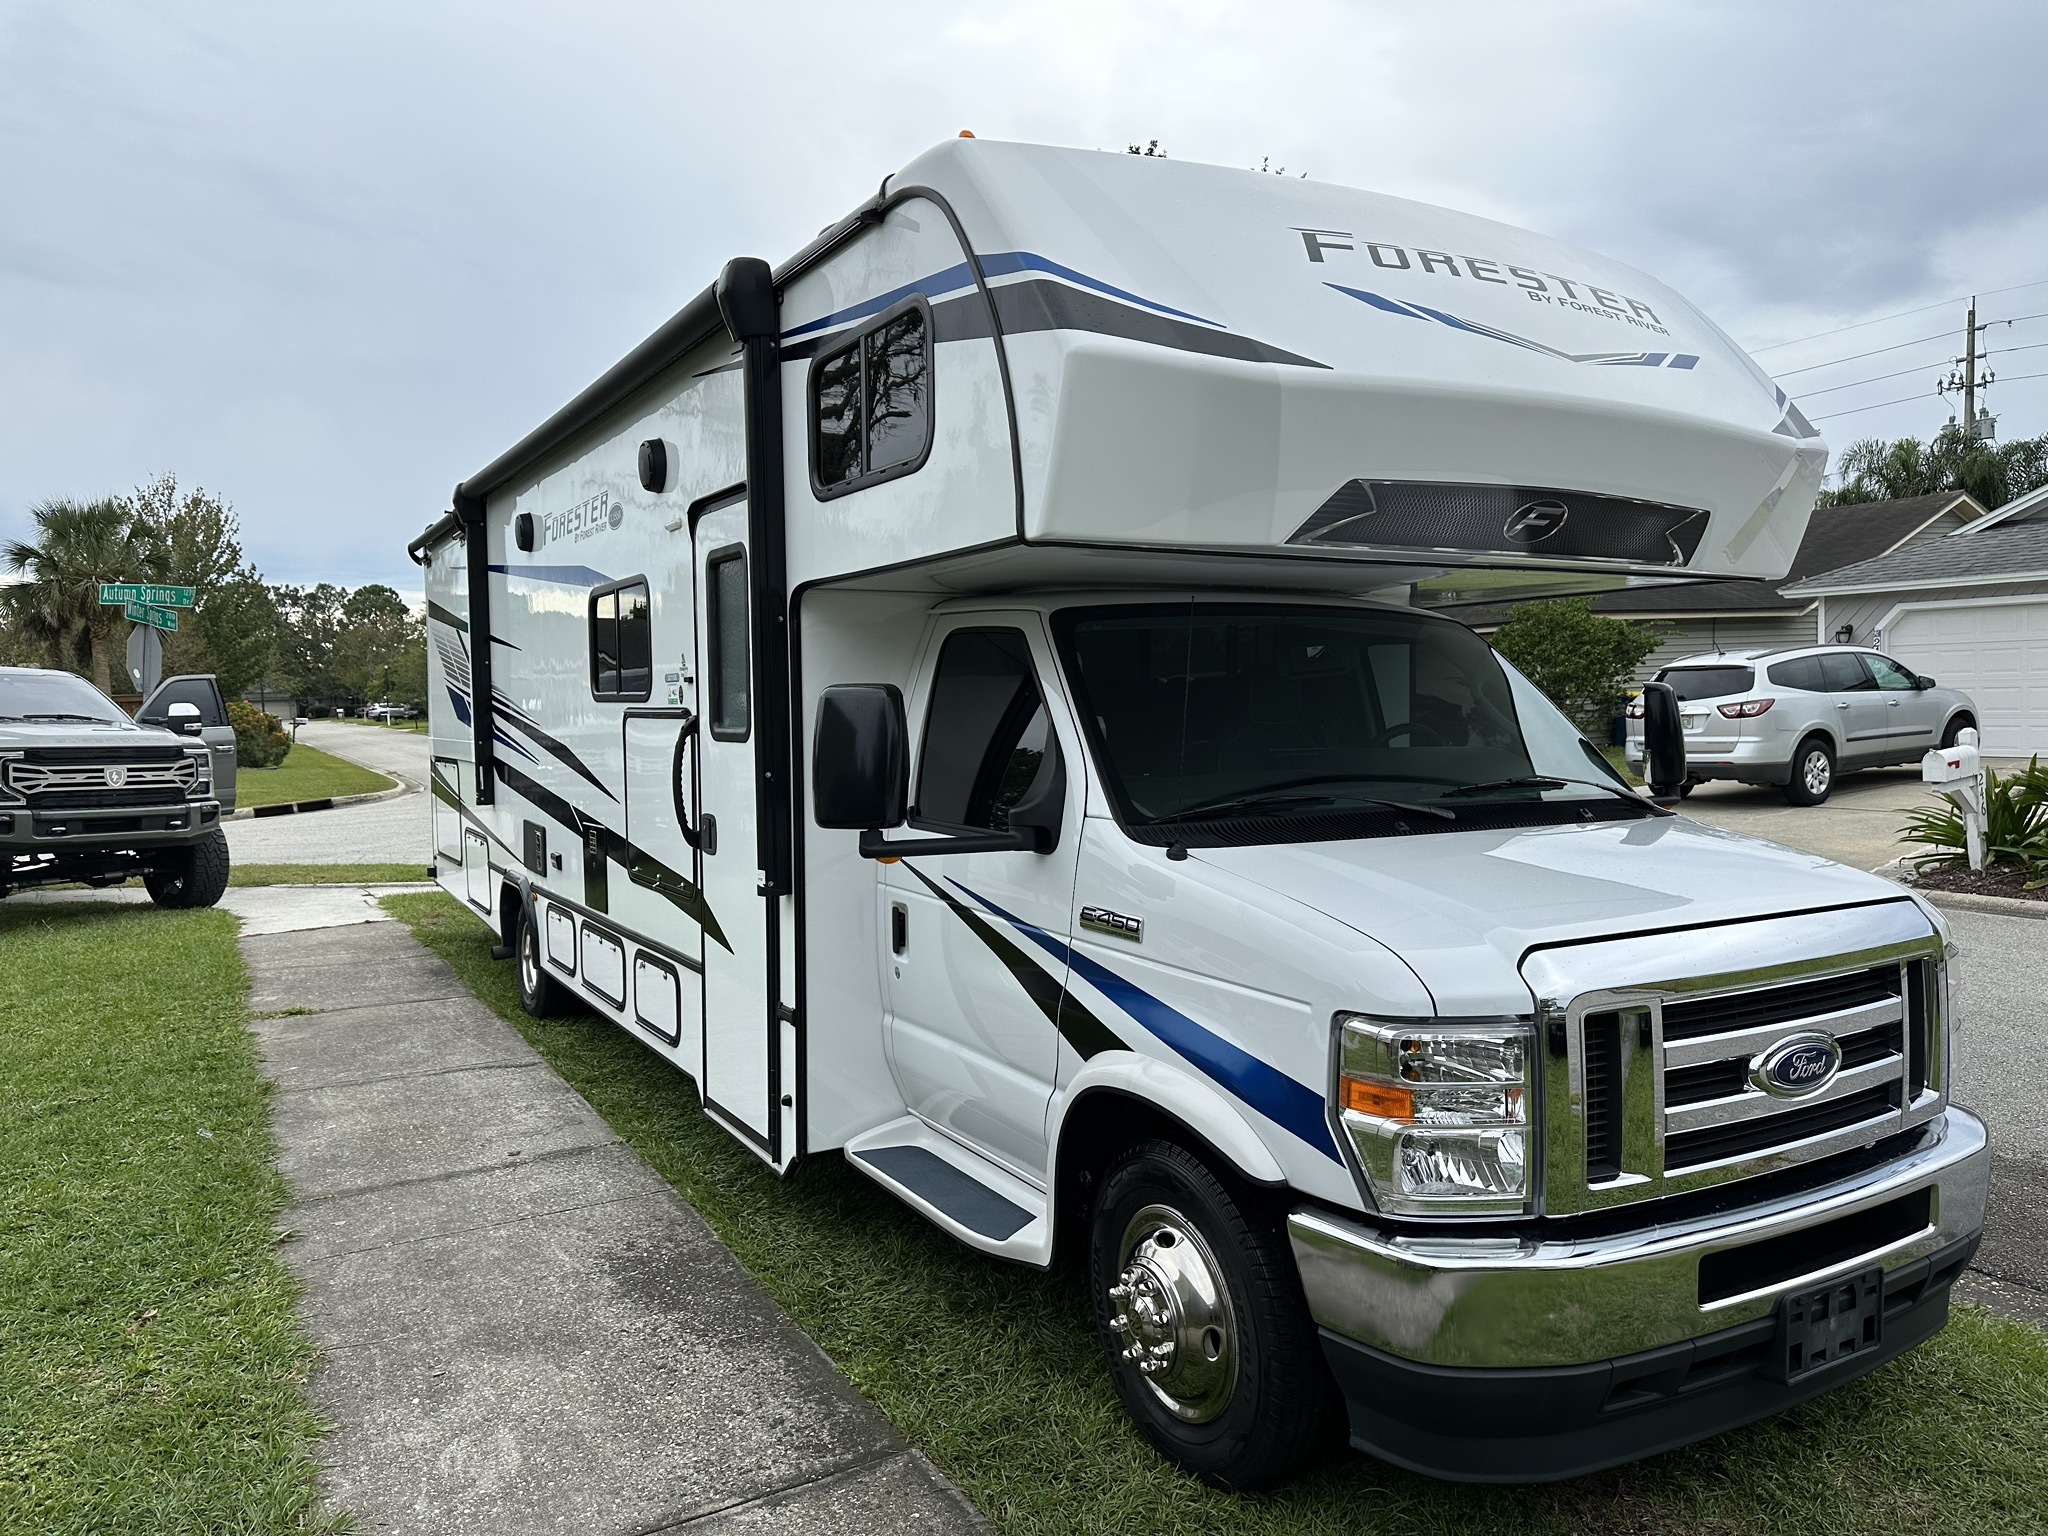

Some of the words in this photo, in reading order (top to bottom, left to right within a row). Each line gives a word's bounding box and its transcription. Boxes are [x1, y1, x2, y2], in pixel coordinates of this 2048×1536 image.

[1287, 226, 1663, 326] FORESTER
[1526, 290, 1552, 304] BY
[1557, 296, 1621, 321] FOREST
[1625, 315, 1671, 337] RIVER
[543, 490, 609, 546] FORESTER
[103, 585, 137, 600] Autumn
[140, 585, 176, 605] Springs
[127, 600, 144, 618] Winter
[1978, 772, 1987, 816] 246
[1081, 906, 1141, 932] E-450
[1789, 1050, 1827, 1081] Ford
